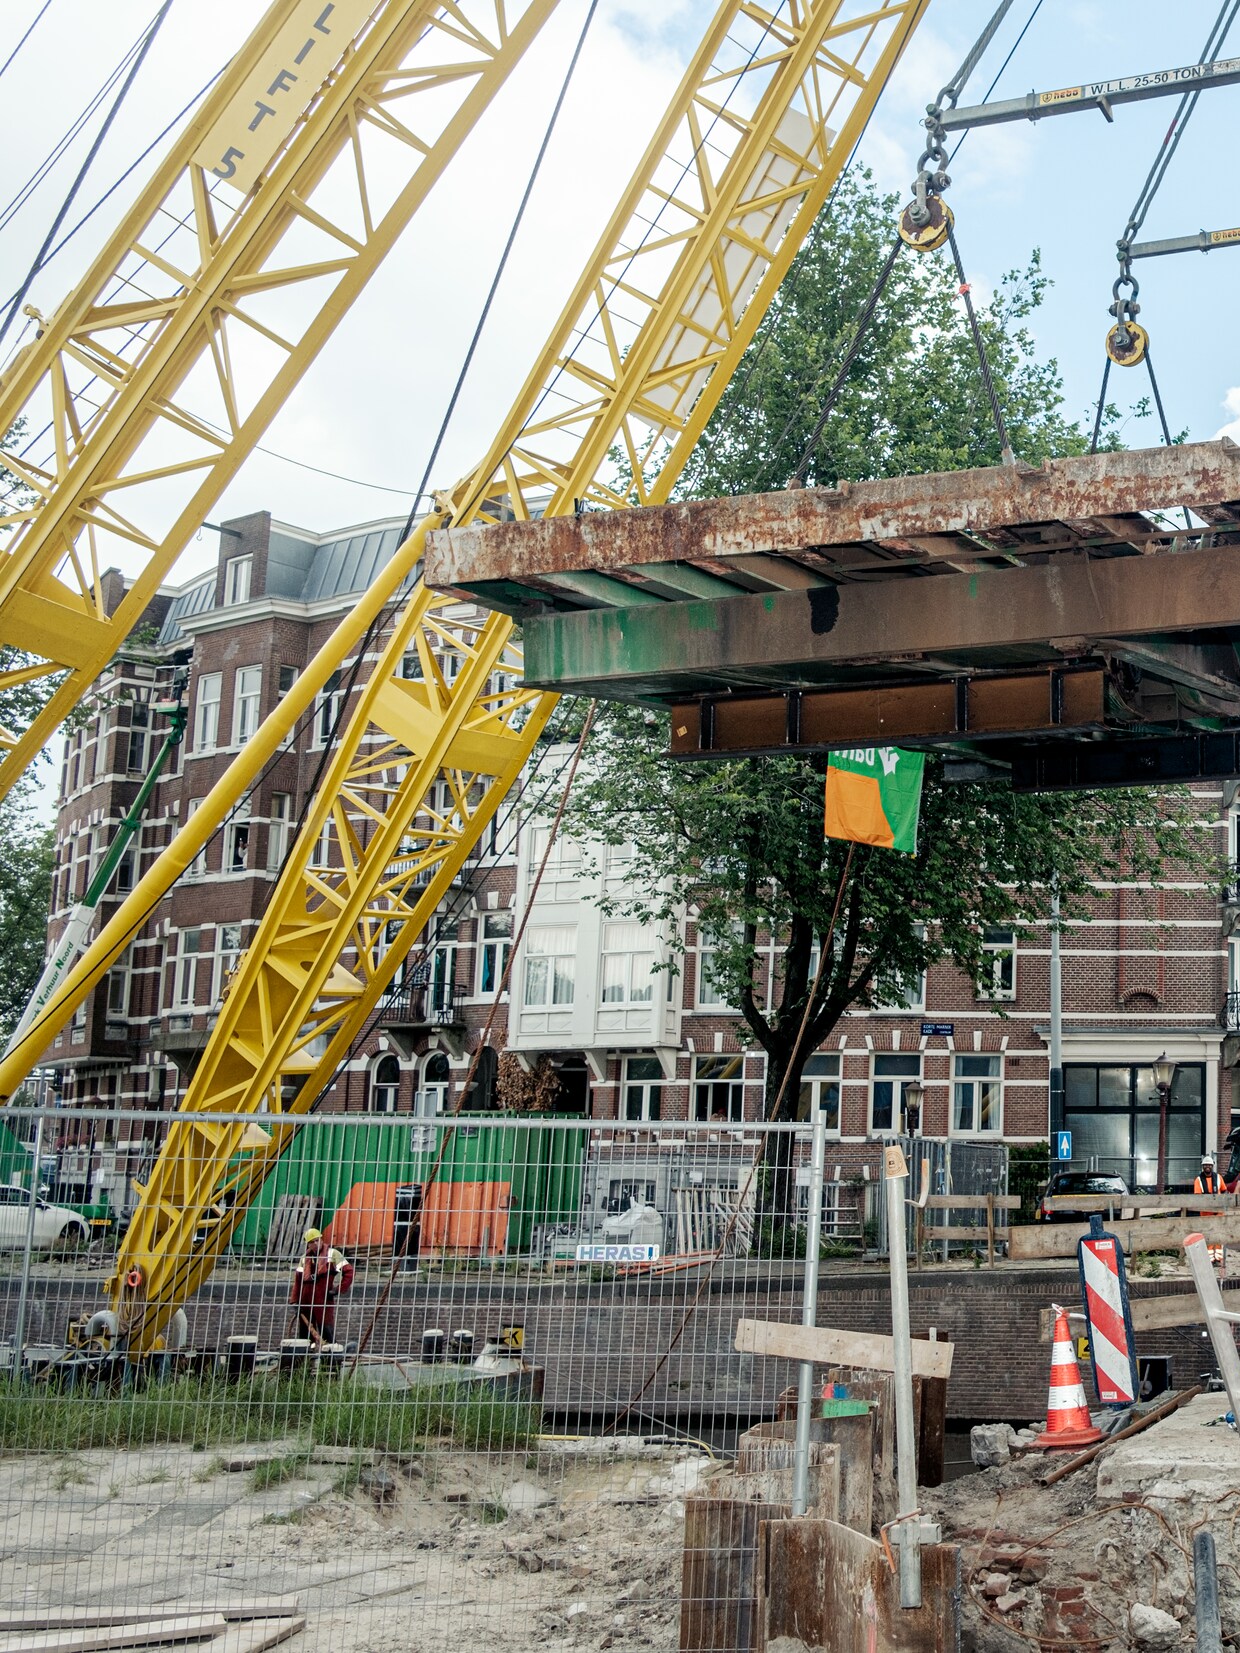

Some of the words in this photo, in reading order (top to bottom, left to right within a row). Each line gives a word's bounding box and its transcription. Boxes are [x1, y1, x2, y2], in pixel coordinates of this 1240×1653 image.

[248, 3, 336, 132] LIFT
[1091, 82, 1130, 96] W.L.L.
[1134, 73, 1169, 88] 25-50
[1173, 66, 1202, 81] TON
[1053, 89, 1079, 99] hebo
[212, 146, 246, 179] 5
[36, 971, 60, 1006] Verhuur
[55, 941, 74, 970] Noord
[580, 1246, 645, 1260] HERAS
